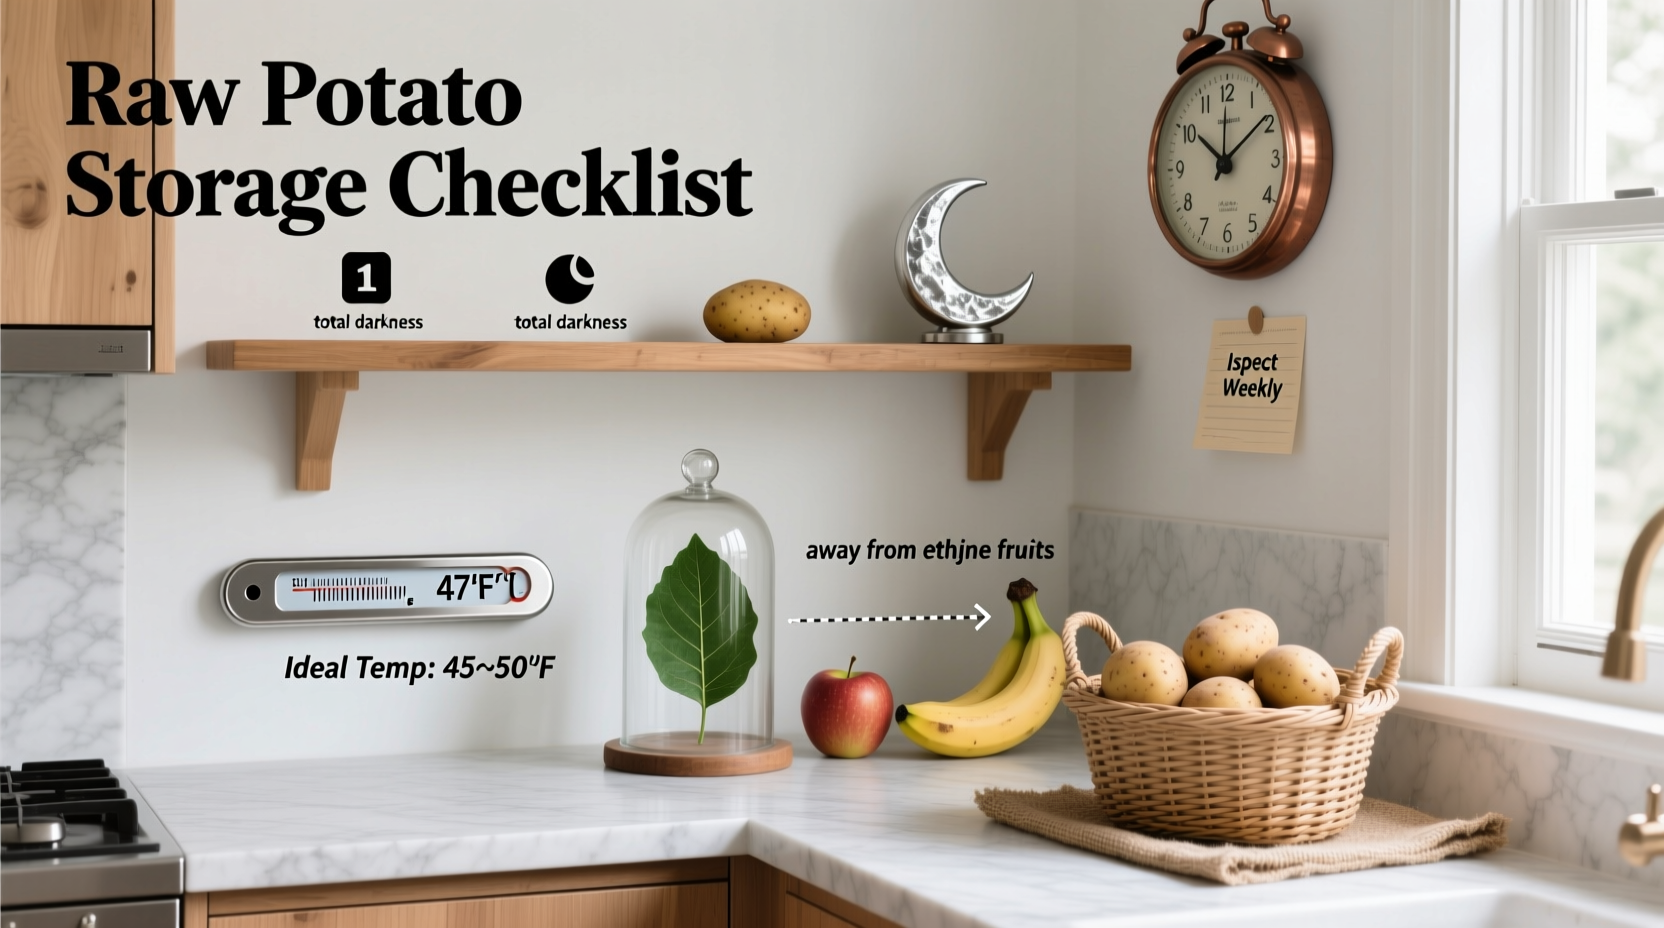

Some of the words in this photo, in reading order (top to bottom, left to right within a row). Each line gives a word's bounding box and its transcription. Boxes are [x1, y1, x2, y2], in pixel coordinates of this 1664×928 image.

[1220, 82, 1235, 103] 12
[1201, 94, 1210, 114] 11
[1182, 123, 1197, 144] 10
[1263, 114, 1275, 133] 2
[1270, 148, 1281, 169] 3
[1175, 159, 1185, 179] 9
[1183, 192, 1193, 212] 8
[1261, 184, 1274, 204] 4
[1199, 217, 1210, 236] 7
[1222, 222, 1233, 244] 6
[1248, 213, 1258, 233] 5
[1227, 352, 1279, 376] Ispect
[1223, 377, 1283, 404] Weekly
